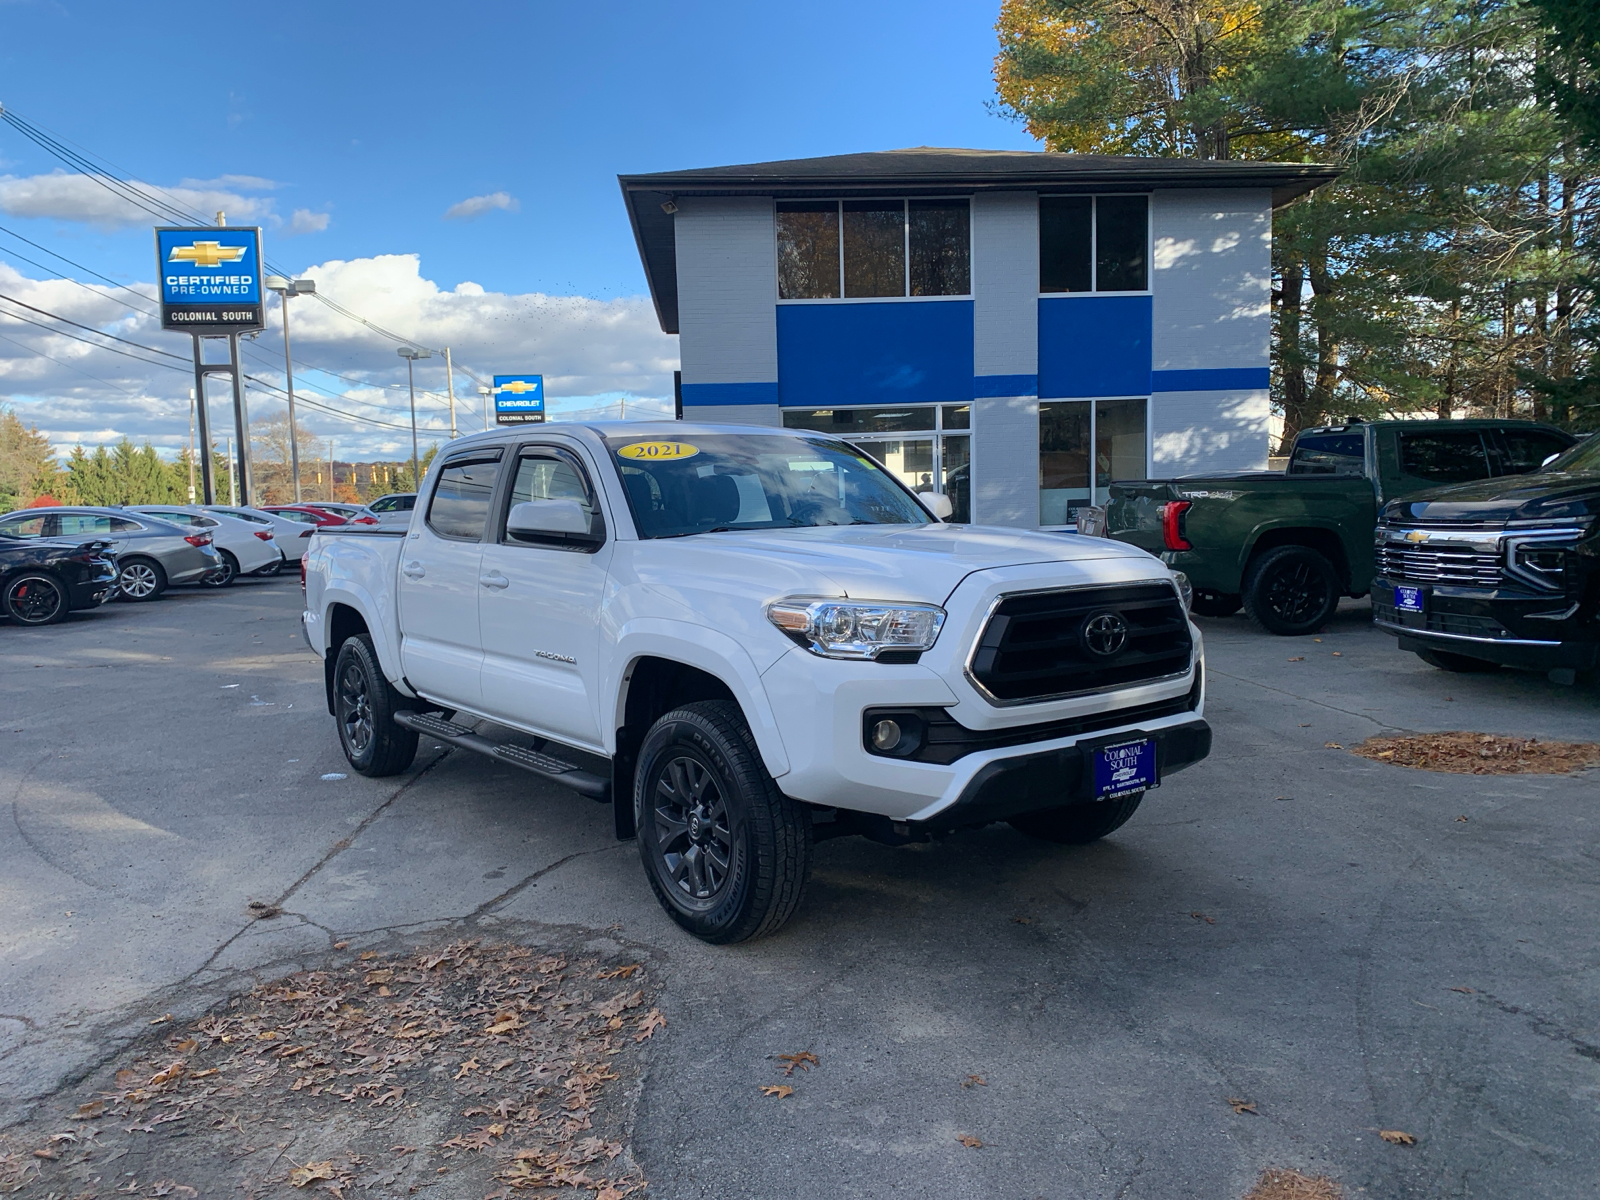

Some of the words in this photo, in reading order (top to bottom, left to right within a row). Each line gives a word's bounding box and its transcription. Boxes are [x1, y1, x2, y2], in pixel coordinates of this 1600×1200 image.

[166, 276, 253, 286] CERTIFIED
[171, 286, 249, 295] PRE-OWNED
[171, 312, 218, 321] COLONIAL
[222, 311, 253, 320] SOUTH
[634, 444, 681, 458] 2021
[1182, 490, 1209, 499] TRD
[533, 649, 577, 665] TACOMA
[1104, 746, 1144, 762] COLONIAL
[1110, 756, 1137, 771] SOUTH
[723, 848, 745, 917] HICOUNTRY
